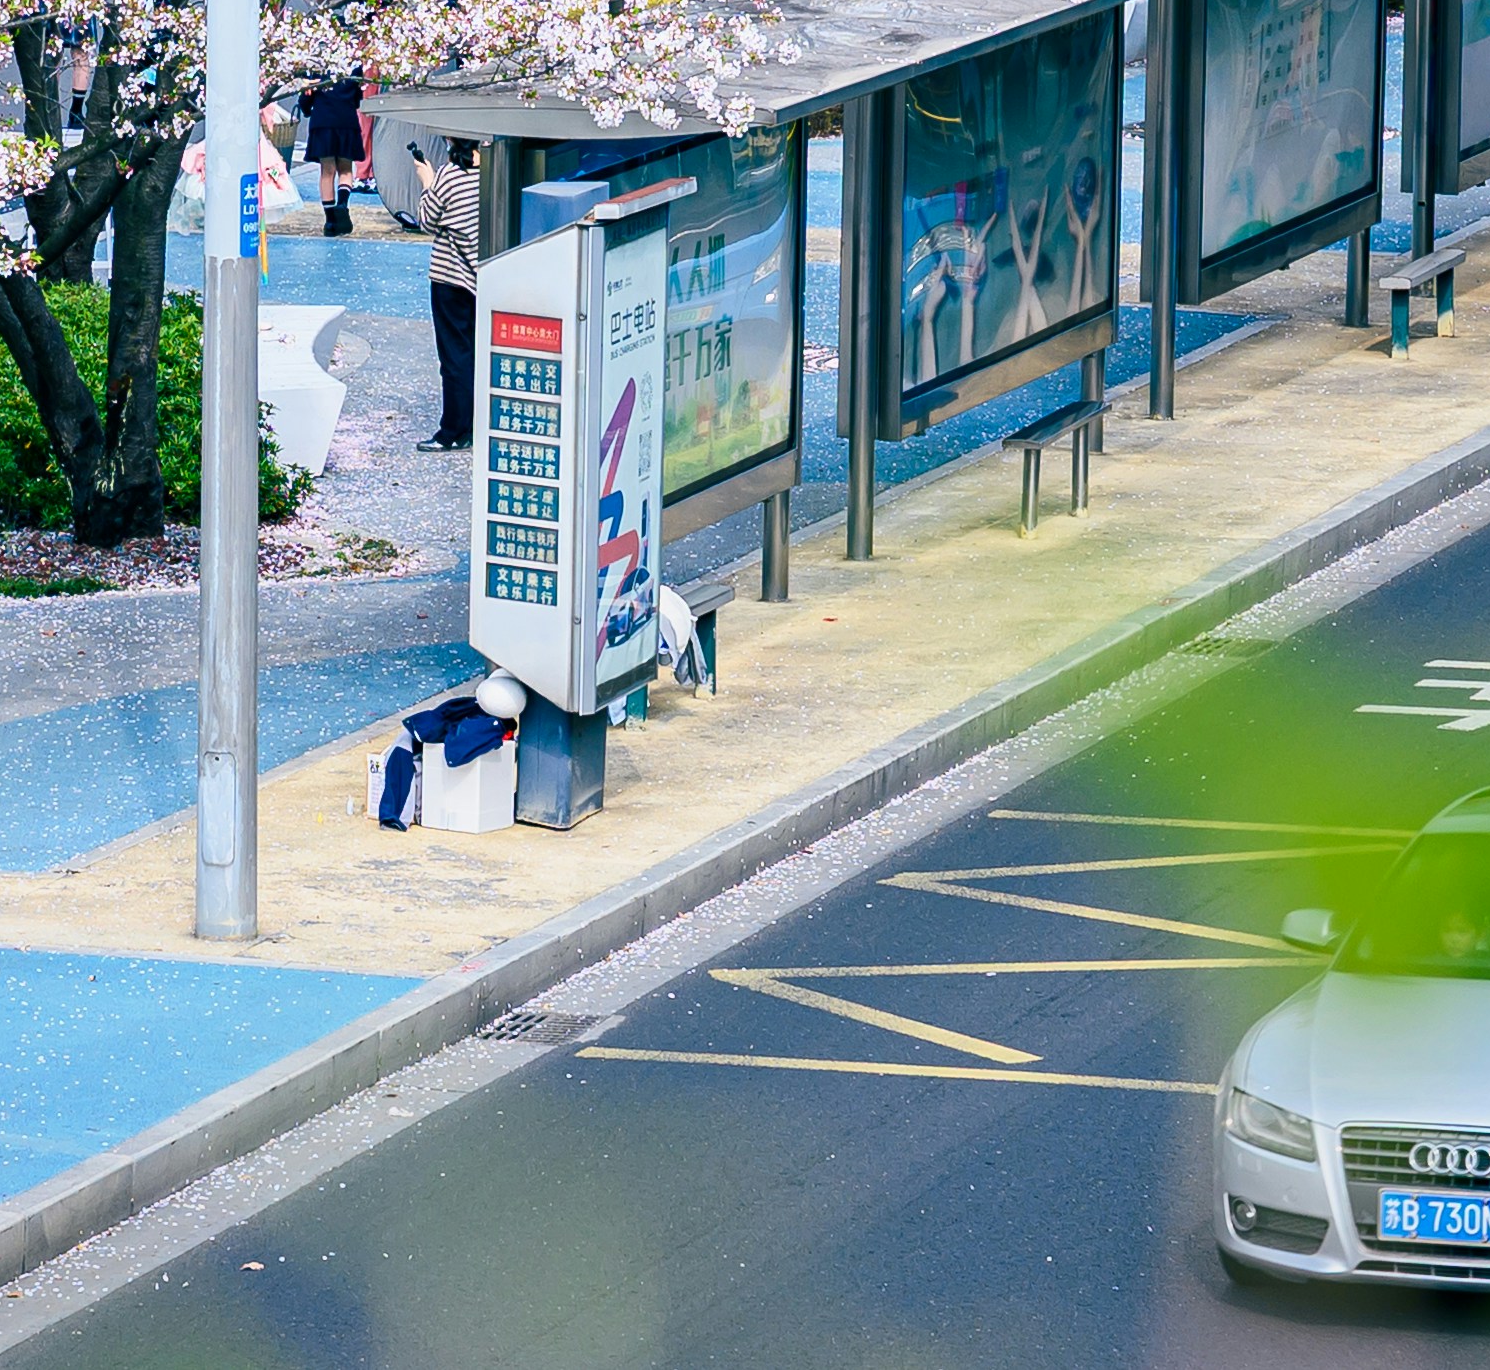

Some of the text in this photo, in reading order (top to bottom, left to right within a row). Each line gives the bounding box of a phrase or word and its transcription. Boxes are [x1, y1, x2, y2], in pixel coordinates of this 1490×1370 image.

[611, 298, 656, 346] 巴士电站
[665, 313, 732, 390] 千万家
[500, 358, 557, 379] 选乘公交
[500, 373, 557, 395] 绿色出行
[500, 399, 558, 421] 平安送到家
[499, 415, 557, 436] 服务千万家
[497, 441, 556, 462] 平安送到家
[497, 457, 556, 478] 服务千万家
[498, 484, 554, 505] 和谐之座
[497, 567, 553, 590] 文明乘车
[496, 583, 553, 605] 快乐同行
